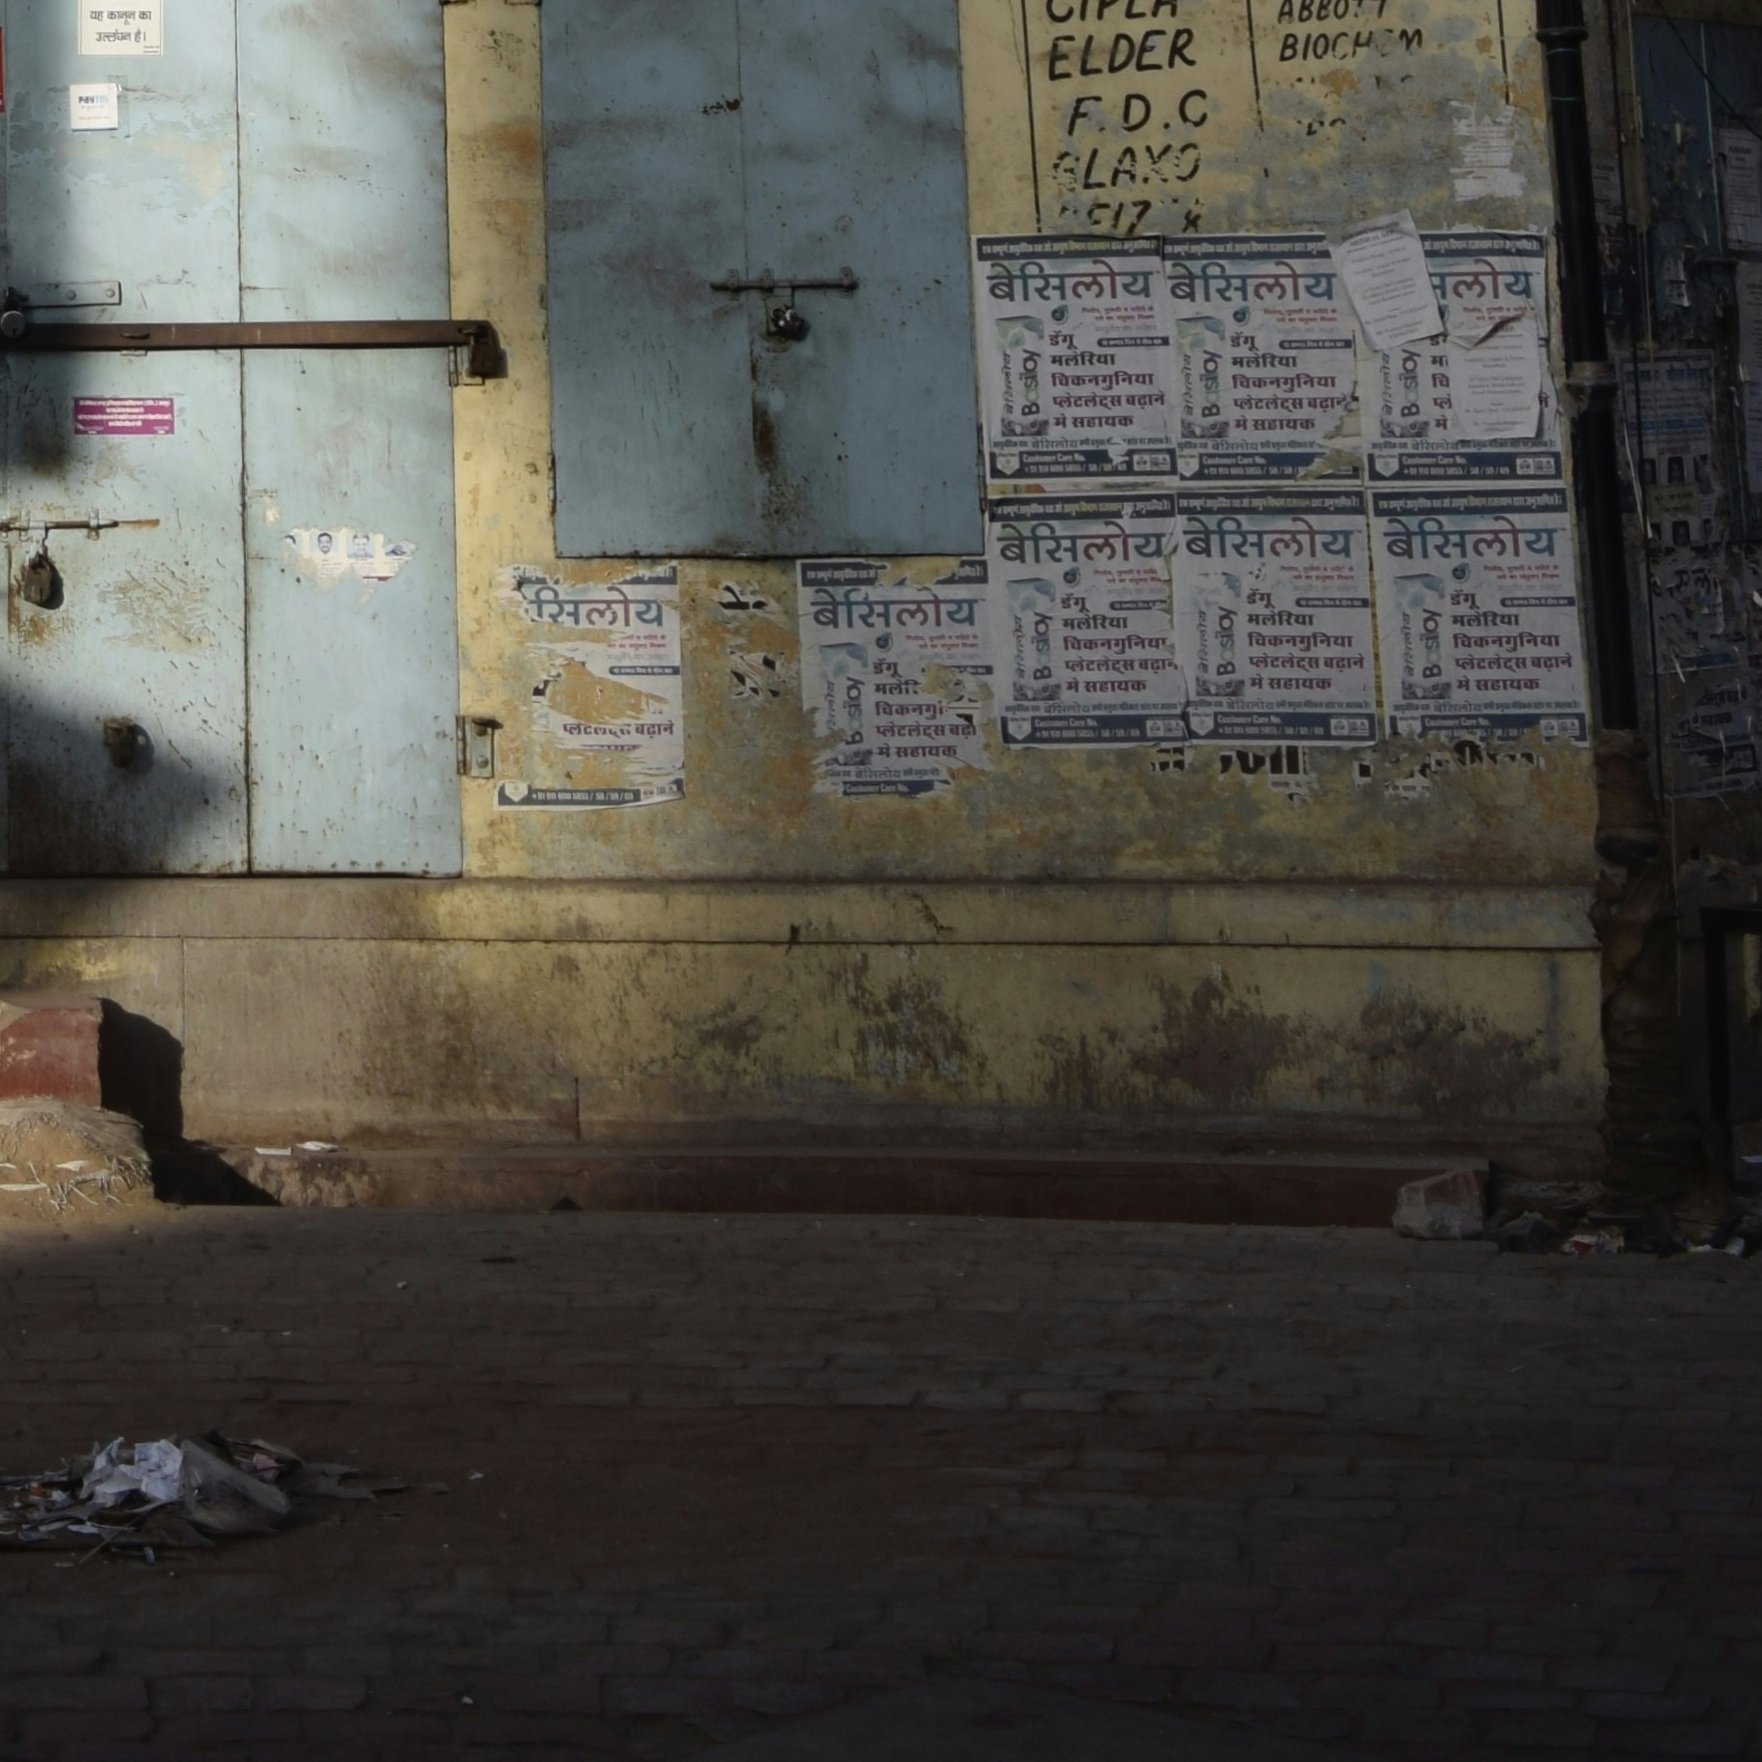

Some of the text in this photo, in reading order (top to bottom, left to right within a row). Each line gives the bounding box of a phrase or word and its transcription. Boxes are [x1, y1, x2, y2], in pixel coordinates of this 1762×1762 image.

[90, 10, 152, 26] यह कानून का
[1048, 28, 1196, 80] ELDER
[986, 260, 1153, 301] बेसिलोय
[1168, 261, 1336, 302] बेसिलोय
[1051, 353, 1115, 366] मलेरिया
[1232, 355, 1297, 368] मलेरिया
[1052, 371, 1154, 390] चिकनगुनिया
[1232, 374, 1336, 392] चिकनगुनिया
[1071, 416, 1134, 428] सहायक
[1253, 418, 1316, 430] सहायक
[998, 522, 1165, 563] बेसिलोय
[1183, 517, 1354, 558] बेसिलोय
[1384, 517, 1558, 559] बेसिलोय
[527, 584, 665, 629] सिलोय
[811, 587, 977, 630] बेसिलोय
[1062, 617, 1127, 629] मलेरिया
[1248, 613, 1314, 626] मलेरिया
[1452, 613, 1519, 626] मलेरिया
[1248, 633, 1352, 651] चिकनगुनिया
[1454, 633, 1559, 652] चिकनगुनिया
[1084, 681, 1147, 693] सहायक
[1268, 677, 1332, 689] सहायक
[1476, 678, 1540, 690] सहायक
